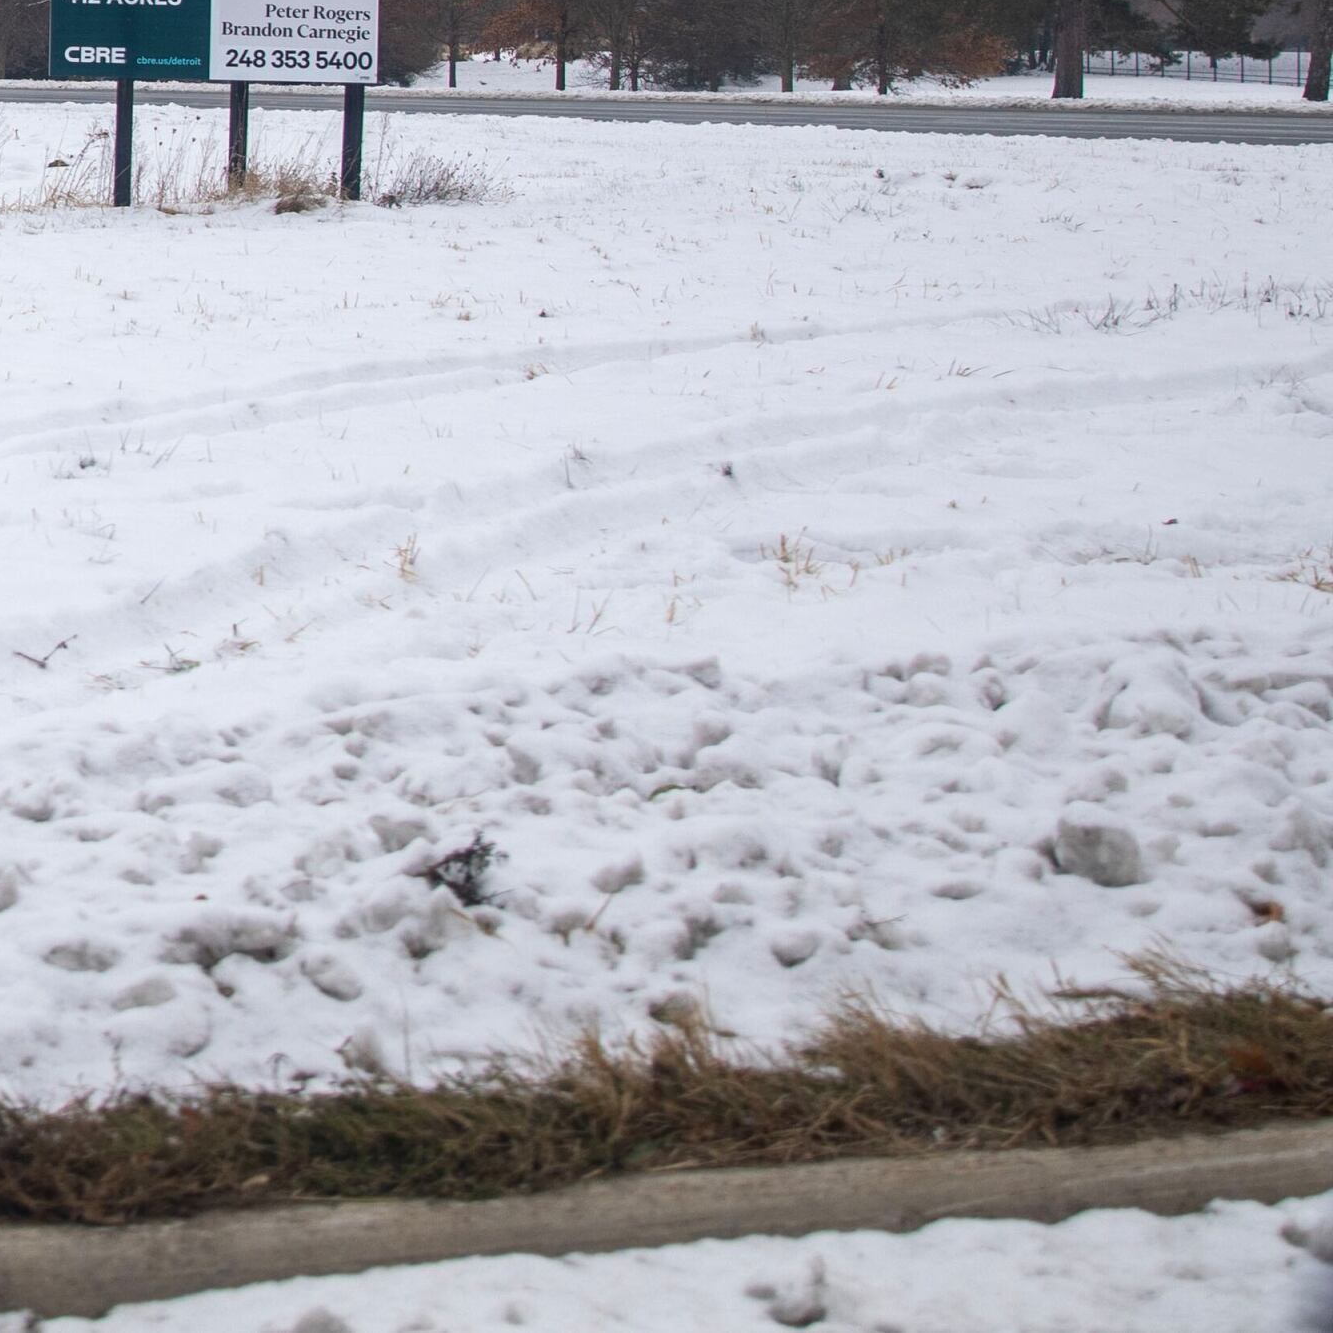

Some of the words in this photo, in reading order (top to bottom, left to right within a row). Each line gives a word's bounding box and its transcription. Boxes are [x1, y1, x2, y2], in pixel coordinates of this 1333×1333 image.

[265, 4, 310, 19] Peter
[313, 6, 371, 23] Rogers
[221, 22, 294, 38] Brandon
[297, 24, 371, 43] Carnegie
[64, 46, 126, 64] CBRE
[136, 56, 201, 66] cbre.us/detroit
[225, 49, 265, 68] 248
[271, 50, 311, 69] 353
[315, 51, 373, 70] 5400
